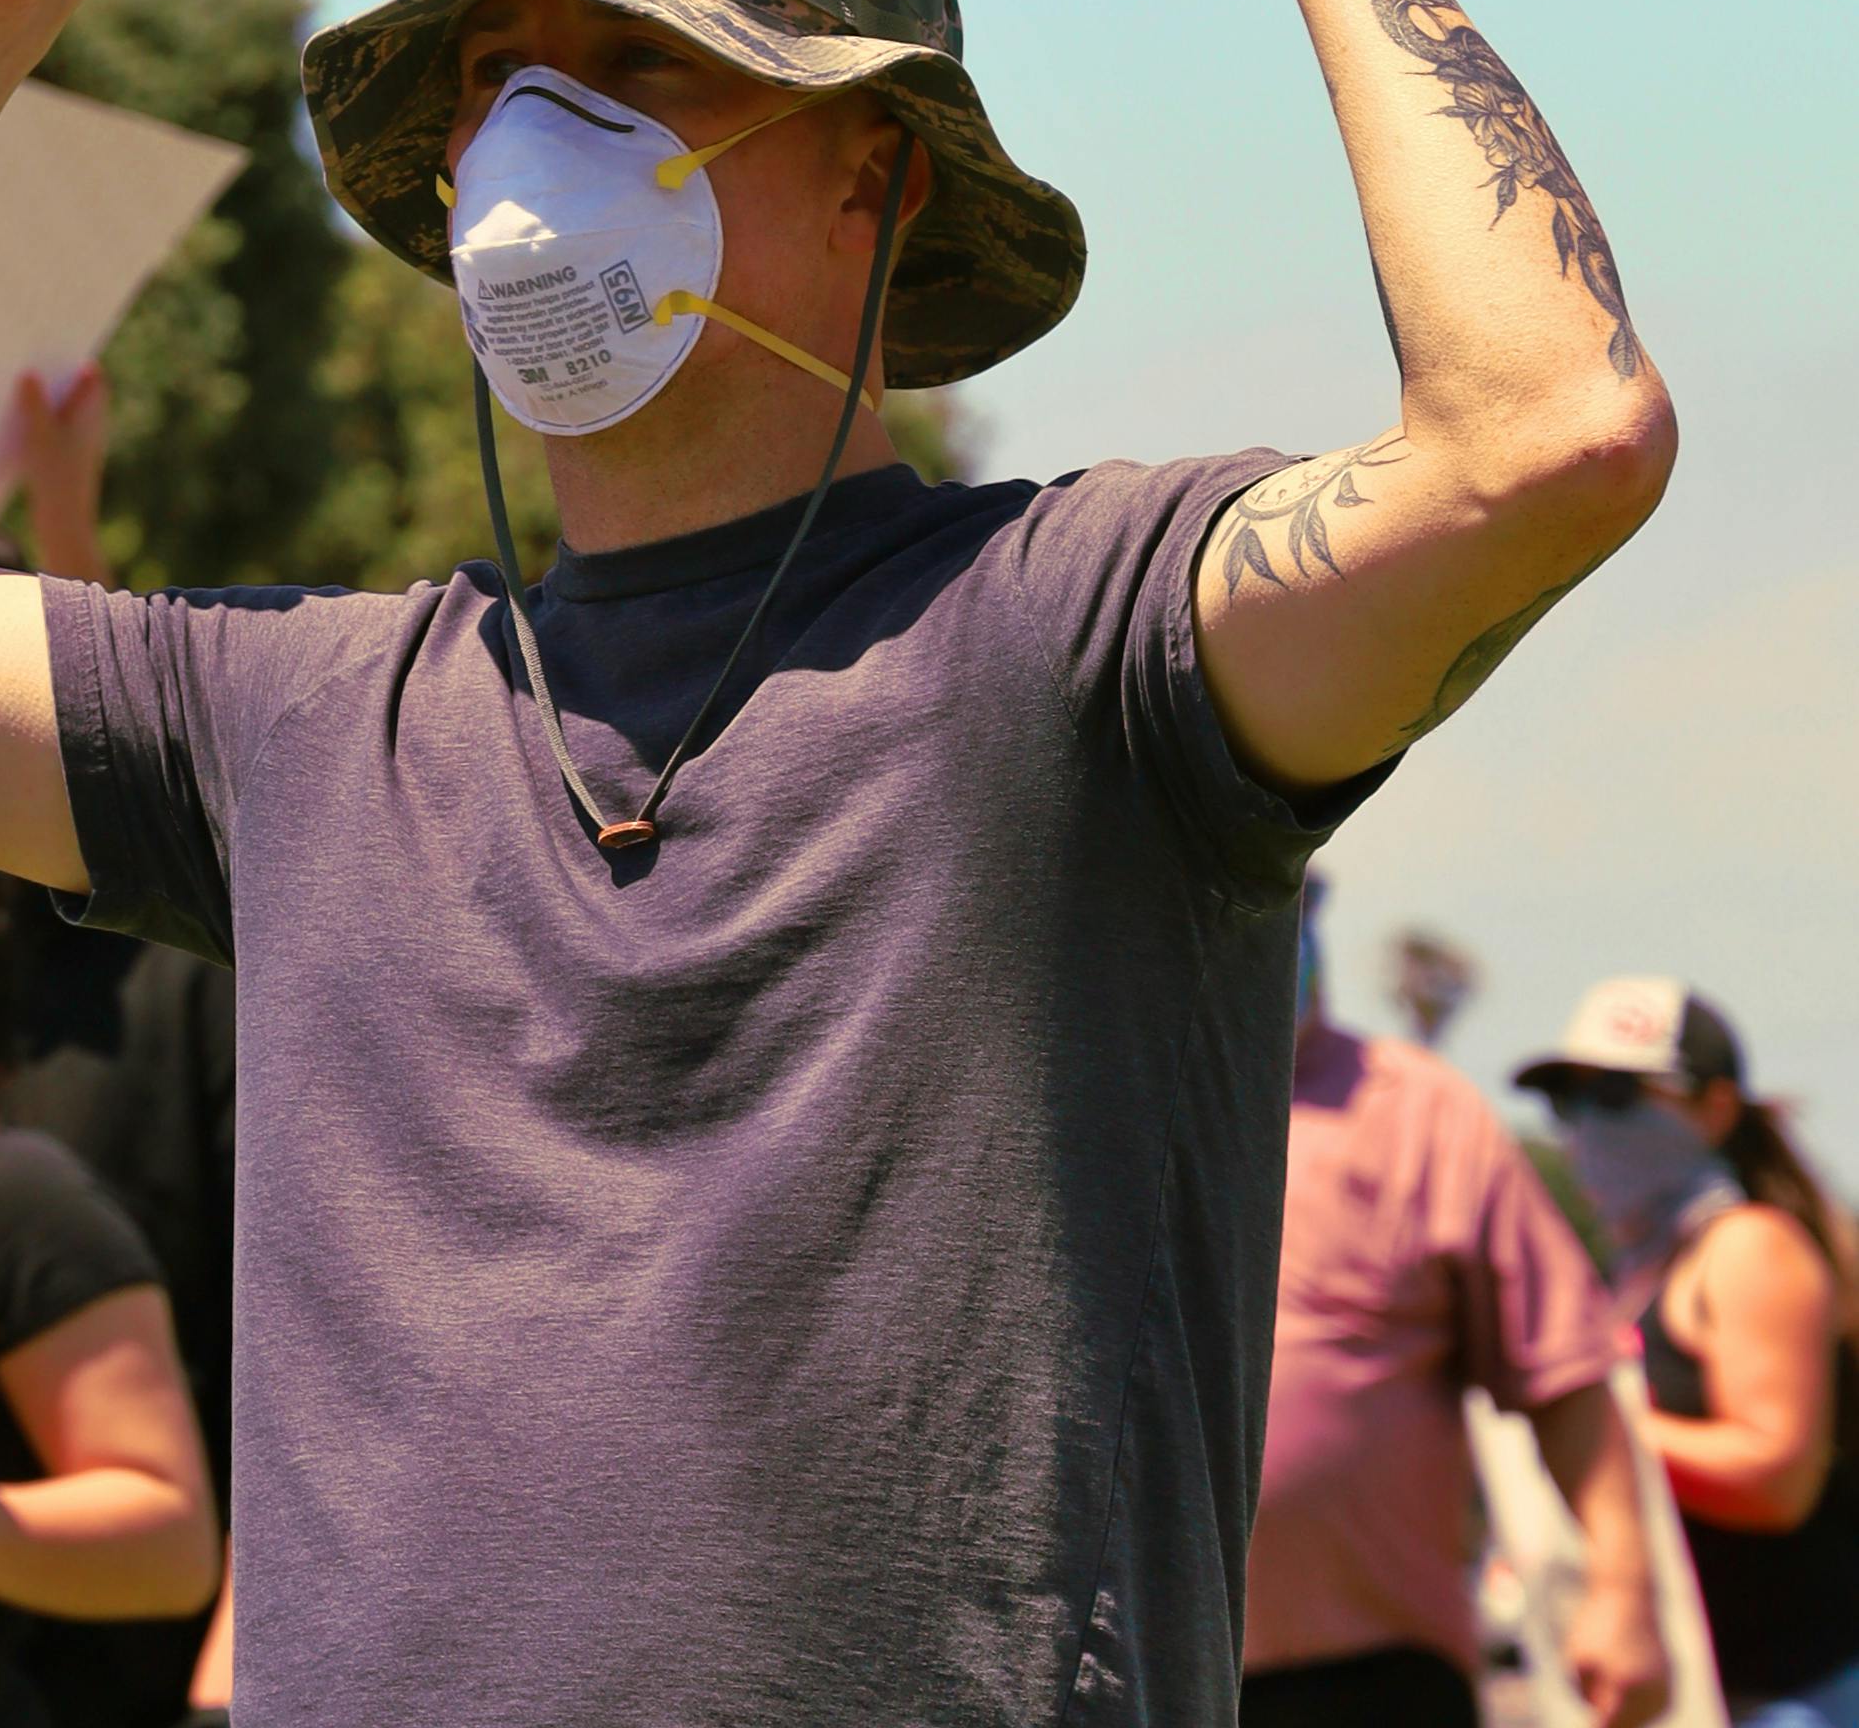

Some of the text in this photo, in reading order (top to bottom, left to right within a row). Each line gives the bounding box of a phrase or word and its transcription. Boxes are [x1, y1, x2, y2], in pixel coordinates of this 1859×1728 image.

[489, 265, 578, 299] WARNING
[606, 269, 646, 325] N95
[517, 348, 613, 385] 3M 8210
